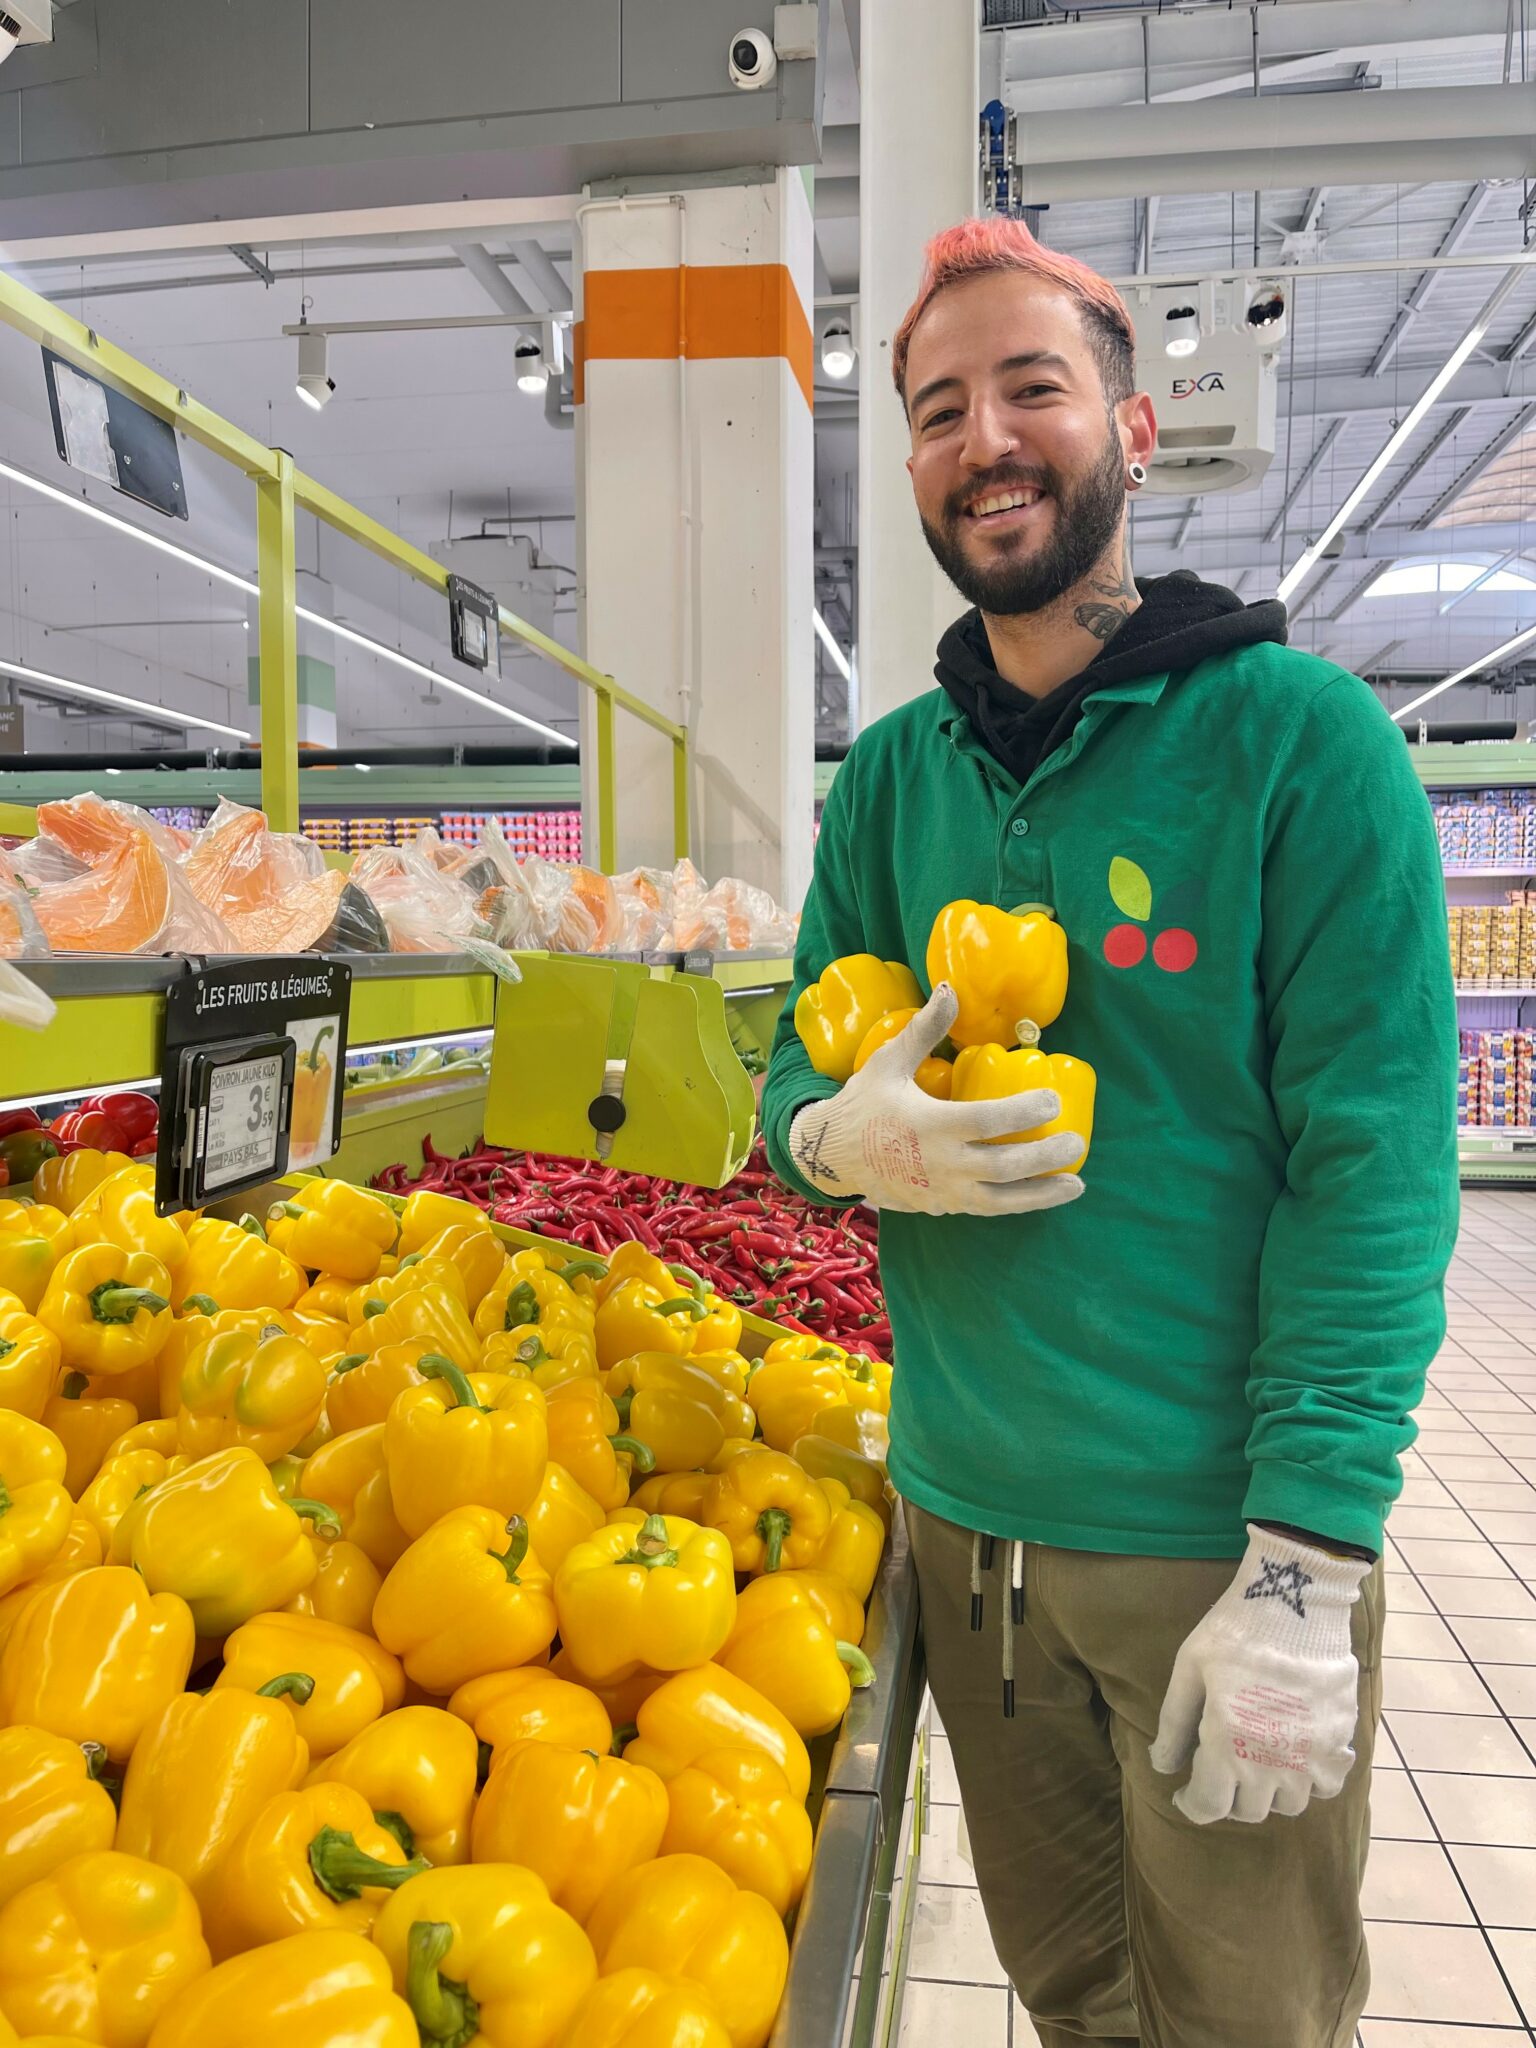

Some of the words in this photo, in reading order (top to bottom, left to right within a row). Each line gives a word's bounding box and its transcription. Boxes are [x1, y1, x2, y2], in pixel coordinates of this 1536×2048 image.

[1170, 372, 1225, 399] EXA
[202, 987, 225, 1009] LES
[227, 981, 268, 1006] FRUITS
[269, 980, 278, 1000] &
[281, 973, 328, 999] LÉGUMES
[211, 1071, 241, 1090] POIVRON
[241, 1065, 262, 1083] JAUNE
[262, 1062, 276, 1078] KILO
[247, 1084, 263, 1132] 3
[261, 1110, 274, 1129] 59
[223, 1149, 244, 1166] PAYS
[244, 1143, 259, 1160] BAS
[907, 1127, 926, 1177] SINGER
[1251, 1751, 1308, 1773] SINGER
